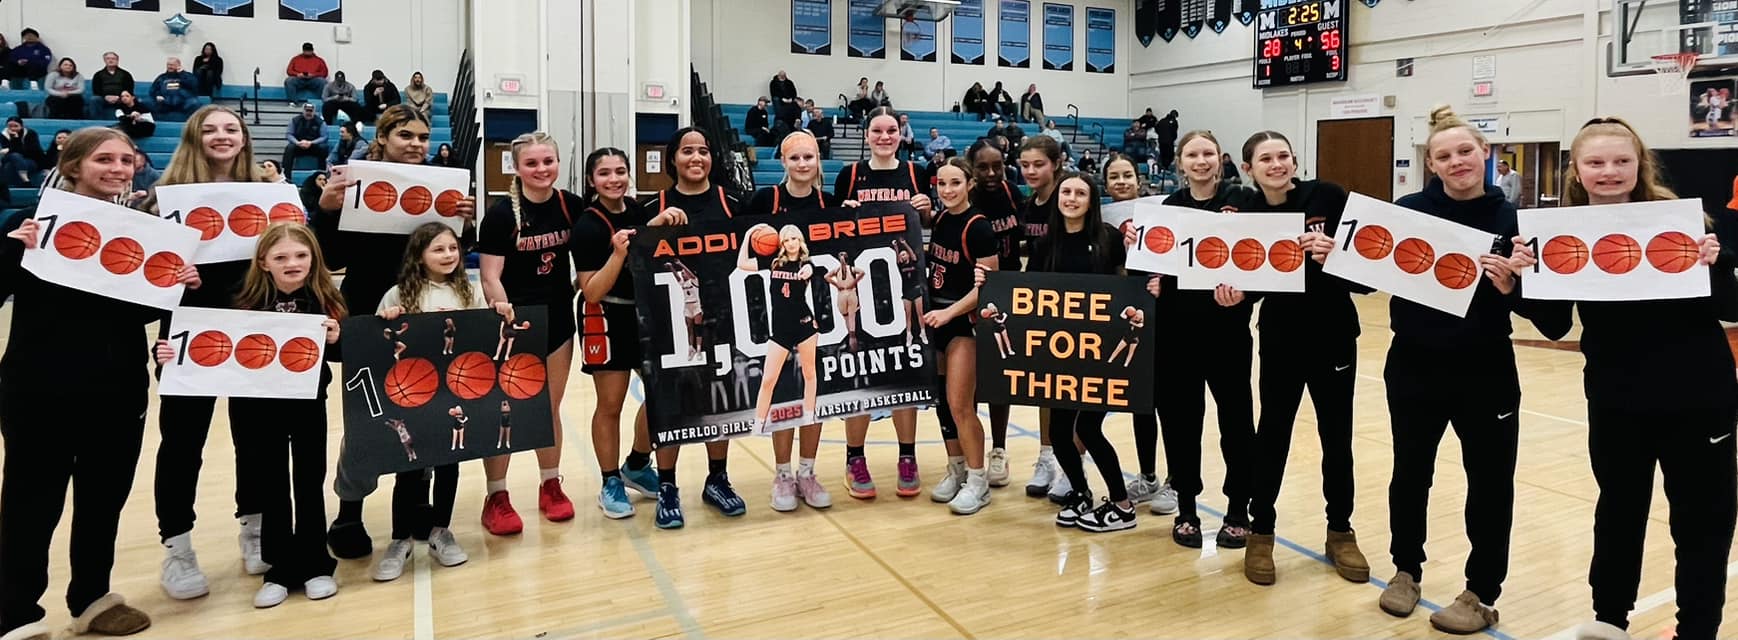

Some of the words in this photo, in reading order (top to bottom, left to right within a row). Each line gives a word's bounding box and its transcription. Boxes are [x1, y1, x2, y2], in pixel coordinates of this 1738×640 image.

[1288, 3, 1319, 24] 2:25
[1317, 21, 1339, 31] GUEST
[1263, 38, 1281, 57] 28
[1294, 38, 1302, 50] 4
[1320, 30, 1340, 49] 56
[1266, 65, 1270, 76] 1
[1332, 55, 1340, 70] 3
[857, 188, 911, 202] WATERLOO
[653, 232, 737, 257] ADDI
[808, 214, 907, 241] BREE
[1012, 287, 1112, 322] BREE
[589, 345, 600, 354] W
[1025, 330, 1101, 360] FOR
[822, 343, 924, 382] POINTS
[1003, 369, 1129, 407] THREE
[657, 423, 718, 443] WATERLOO
[770, 405, 803, 422] 2025
[815, 399, 859, 417] VARSITY
[863, 389, 932, 409] BASKETBALL
